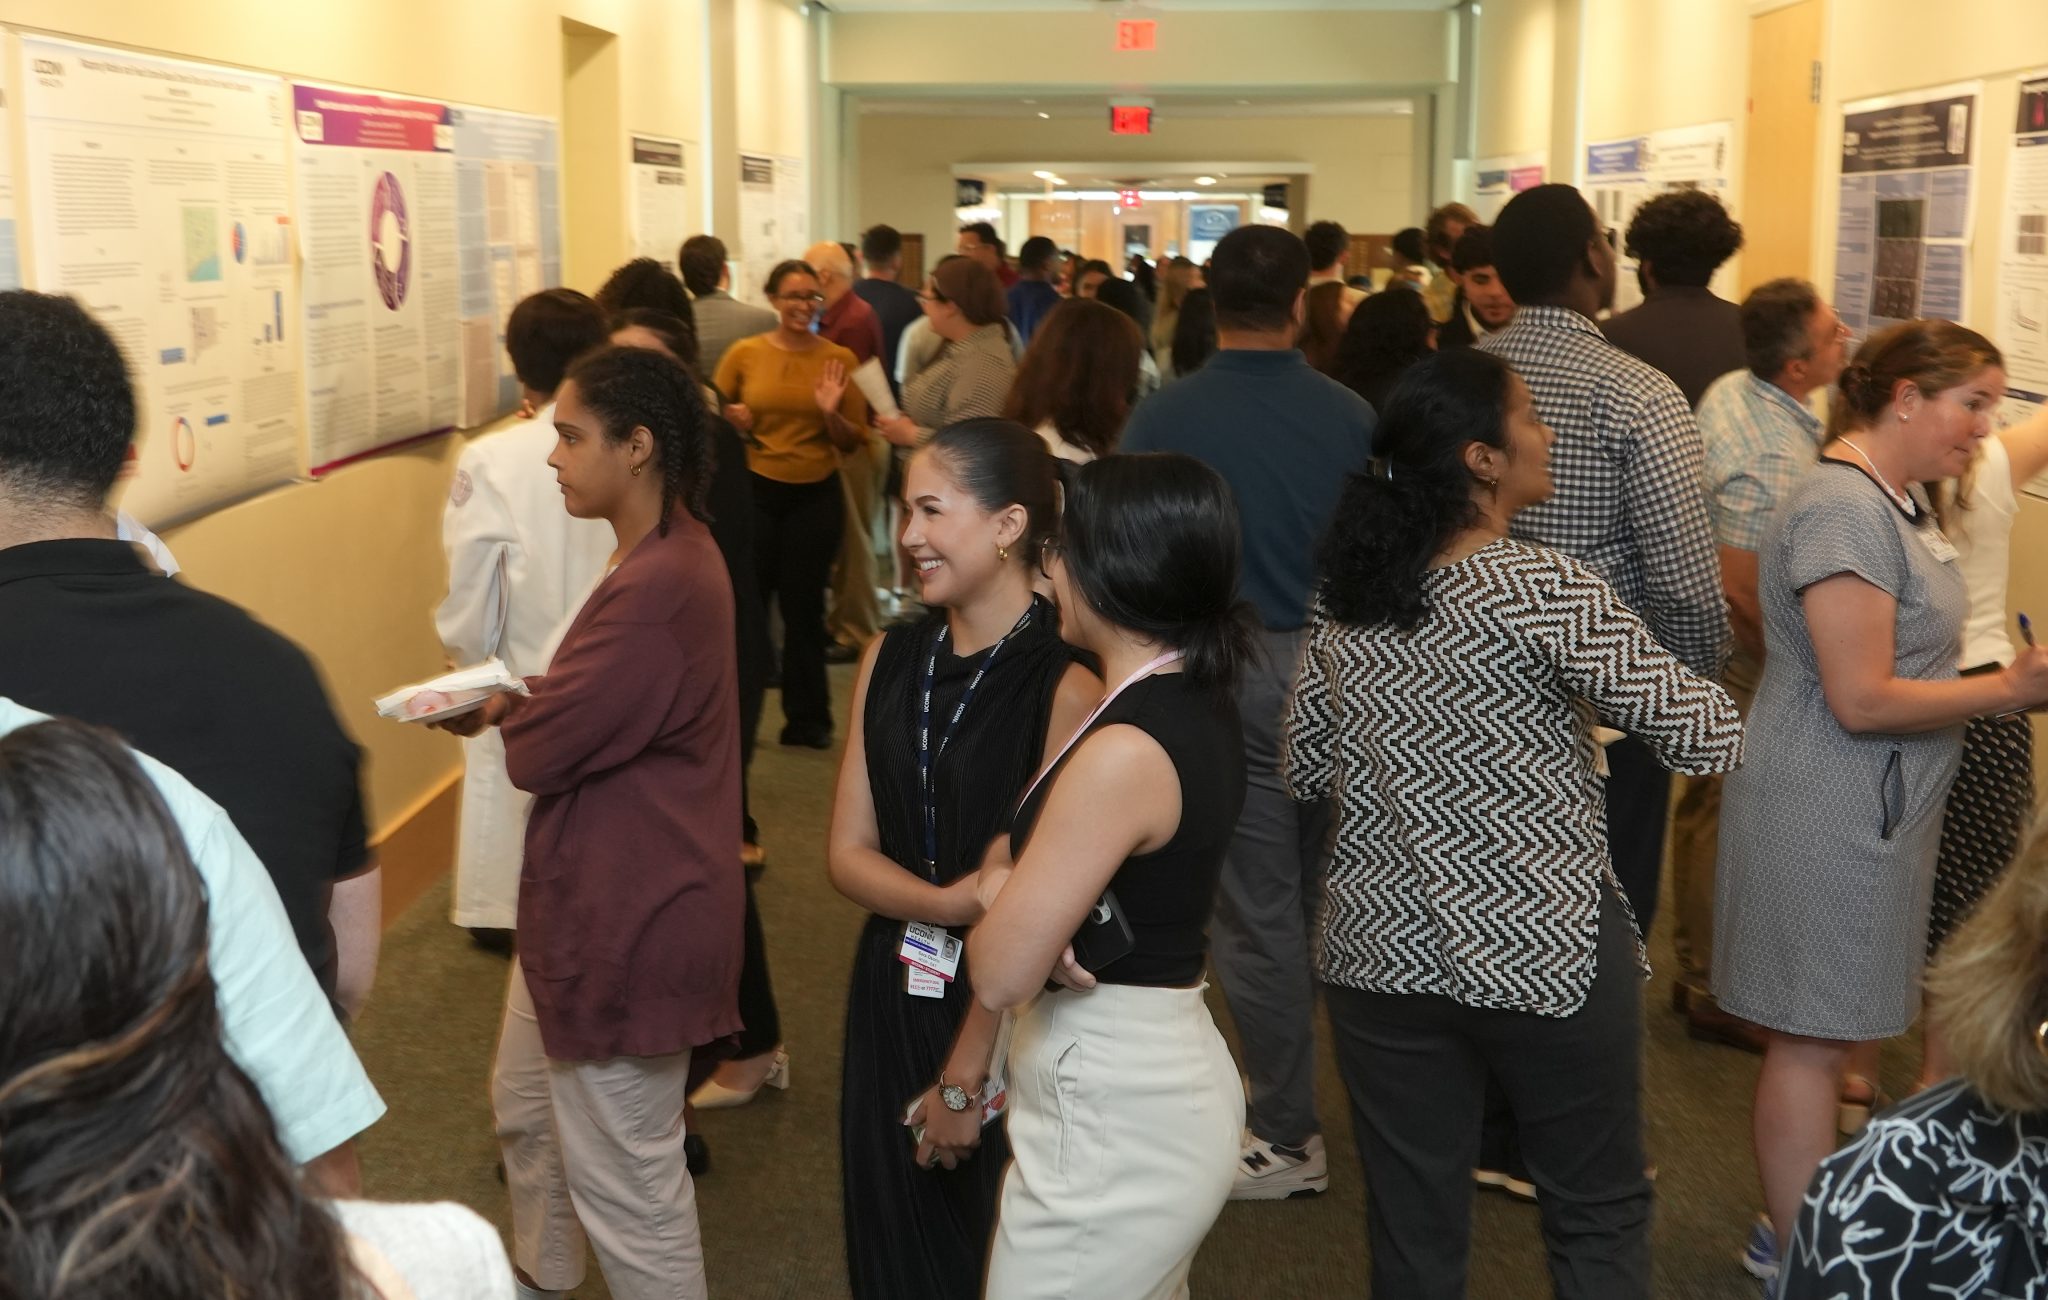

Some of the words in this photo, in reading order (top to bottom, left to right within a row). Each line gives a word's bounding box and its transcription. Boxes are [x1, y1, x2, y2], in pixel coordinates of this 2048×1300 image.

[923, 690, 931, 713] UCONN
[952, 703, 966, 724] UCONN
[909, 925, 936, 942] UCONN
